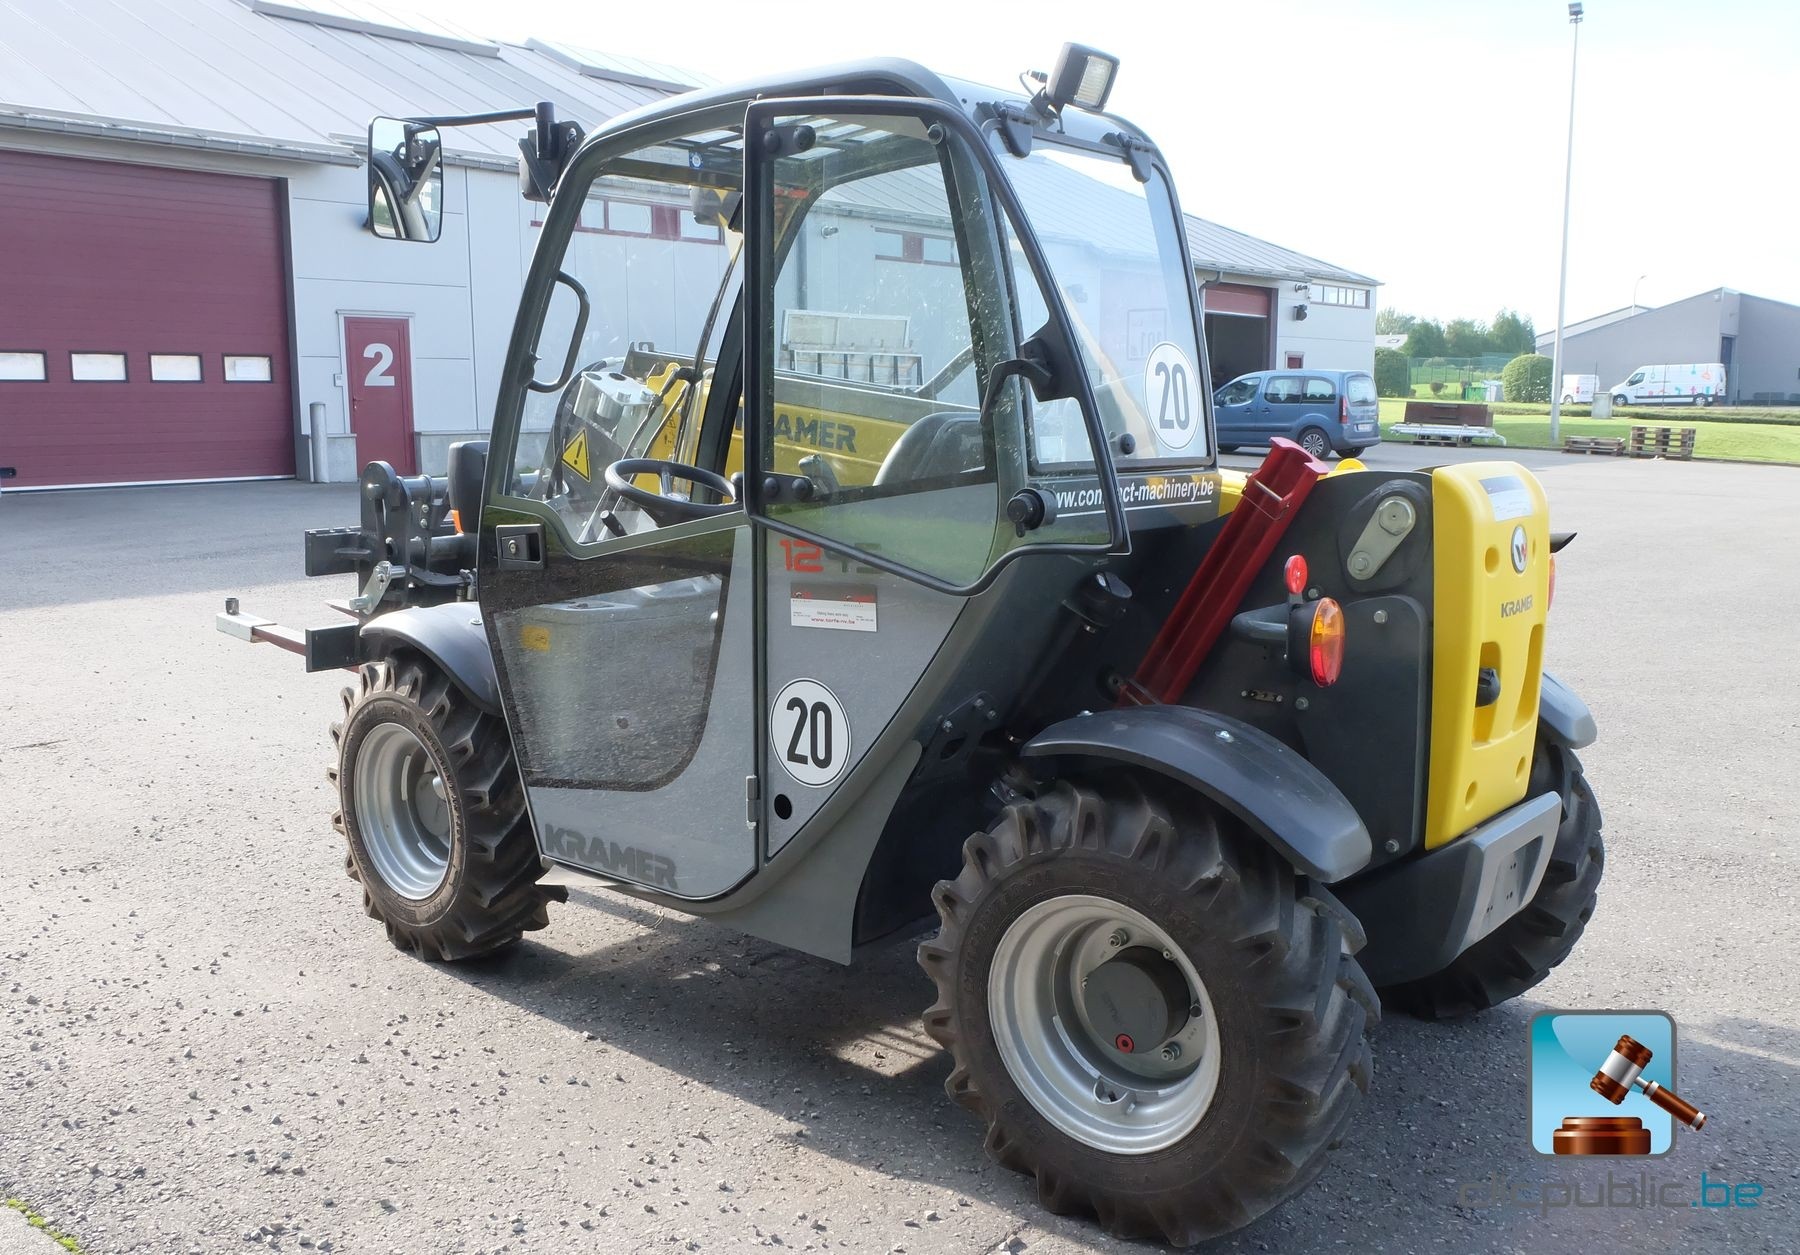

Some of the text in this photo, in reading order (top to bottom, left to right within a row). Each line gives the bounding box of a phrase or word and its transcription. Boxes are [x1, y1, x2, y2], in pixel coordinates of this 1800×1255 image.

[363, 343, 395, 386] 2
[1155, 361, 1190, 431] 20
[736, 406, 857, 453] AMER
[1501, 594, 1532, 618] KRAMER
[786, 696, 832, 769] 20
[545, 823, 679, 890] KRAMER
